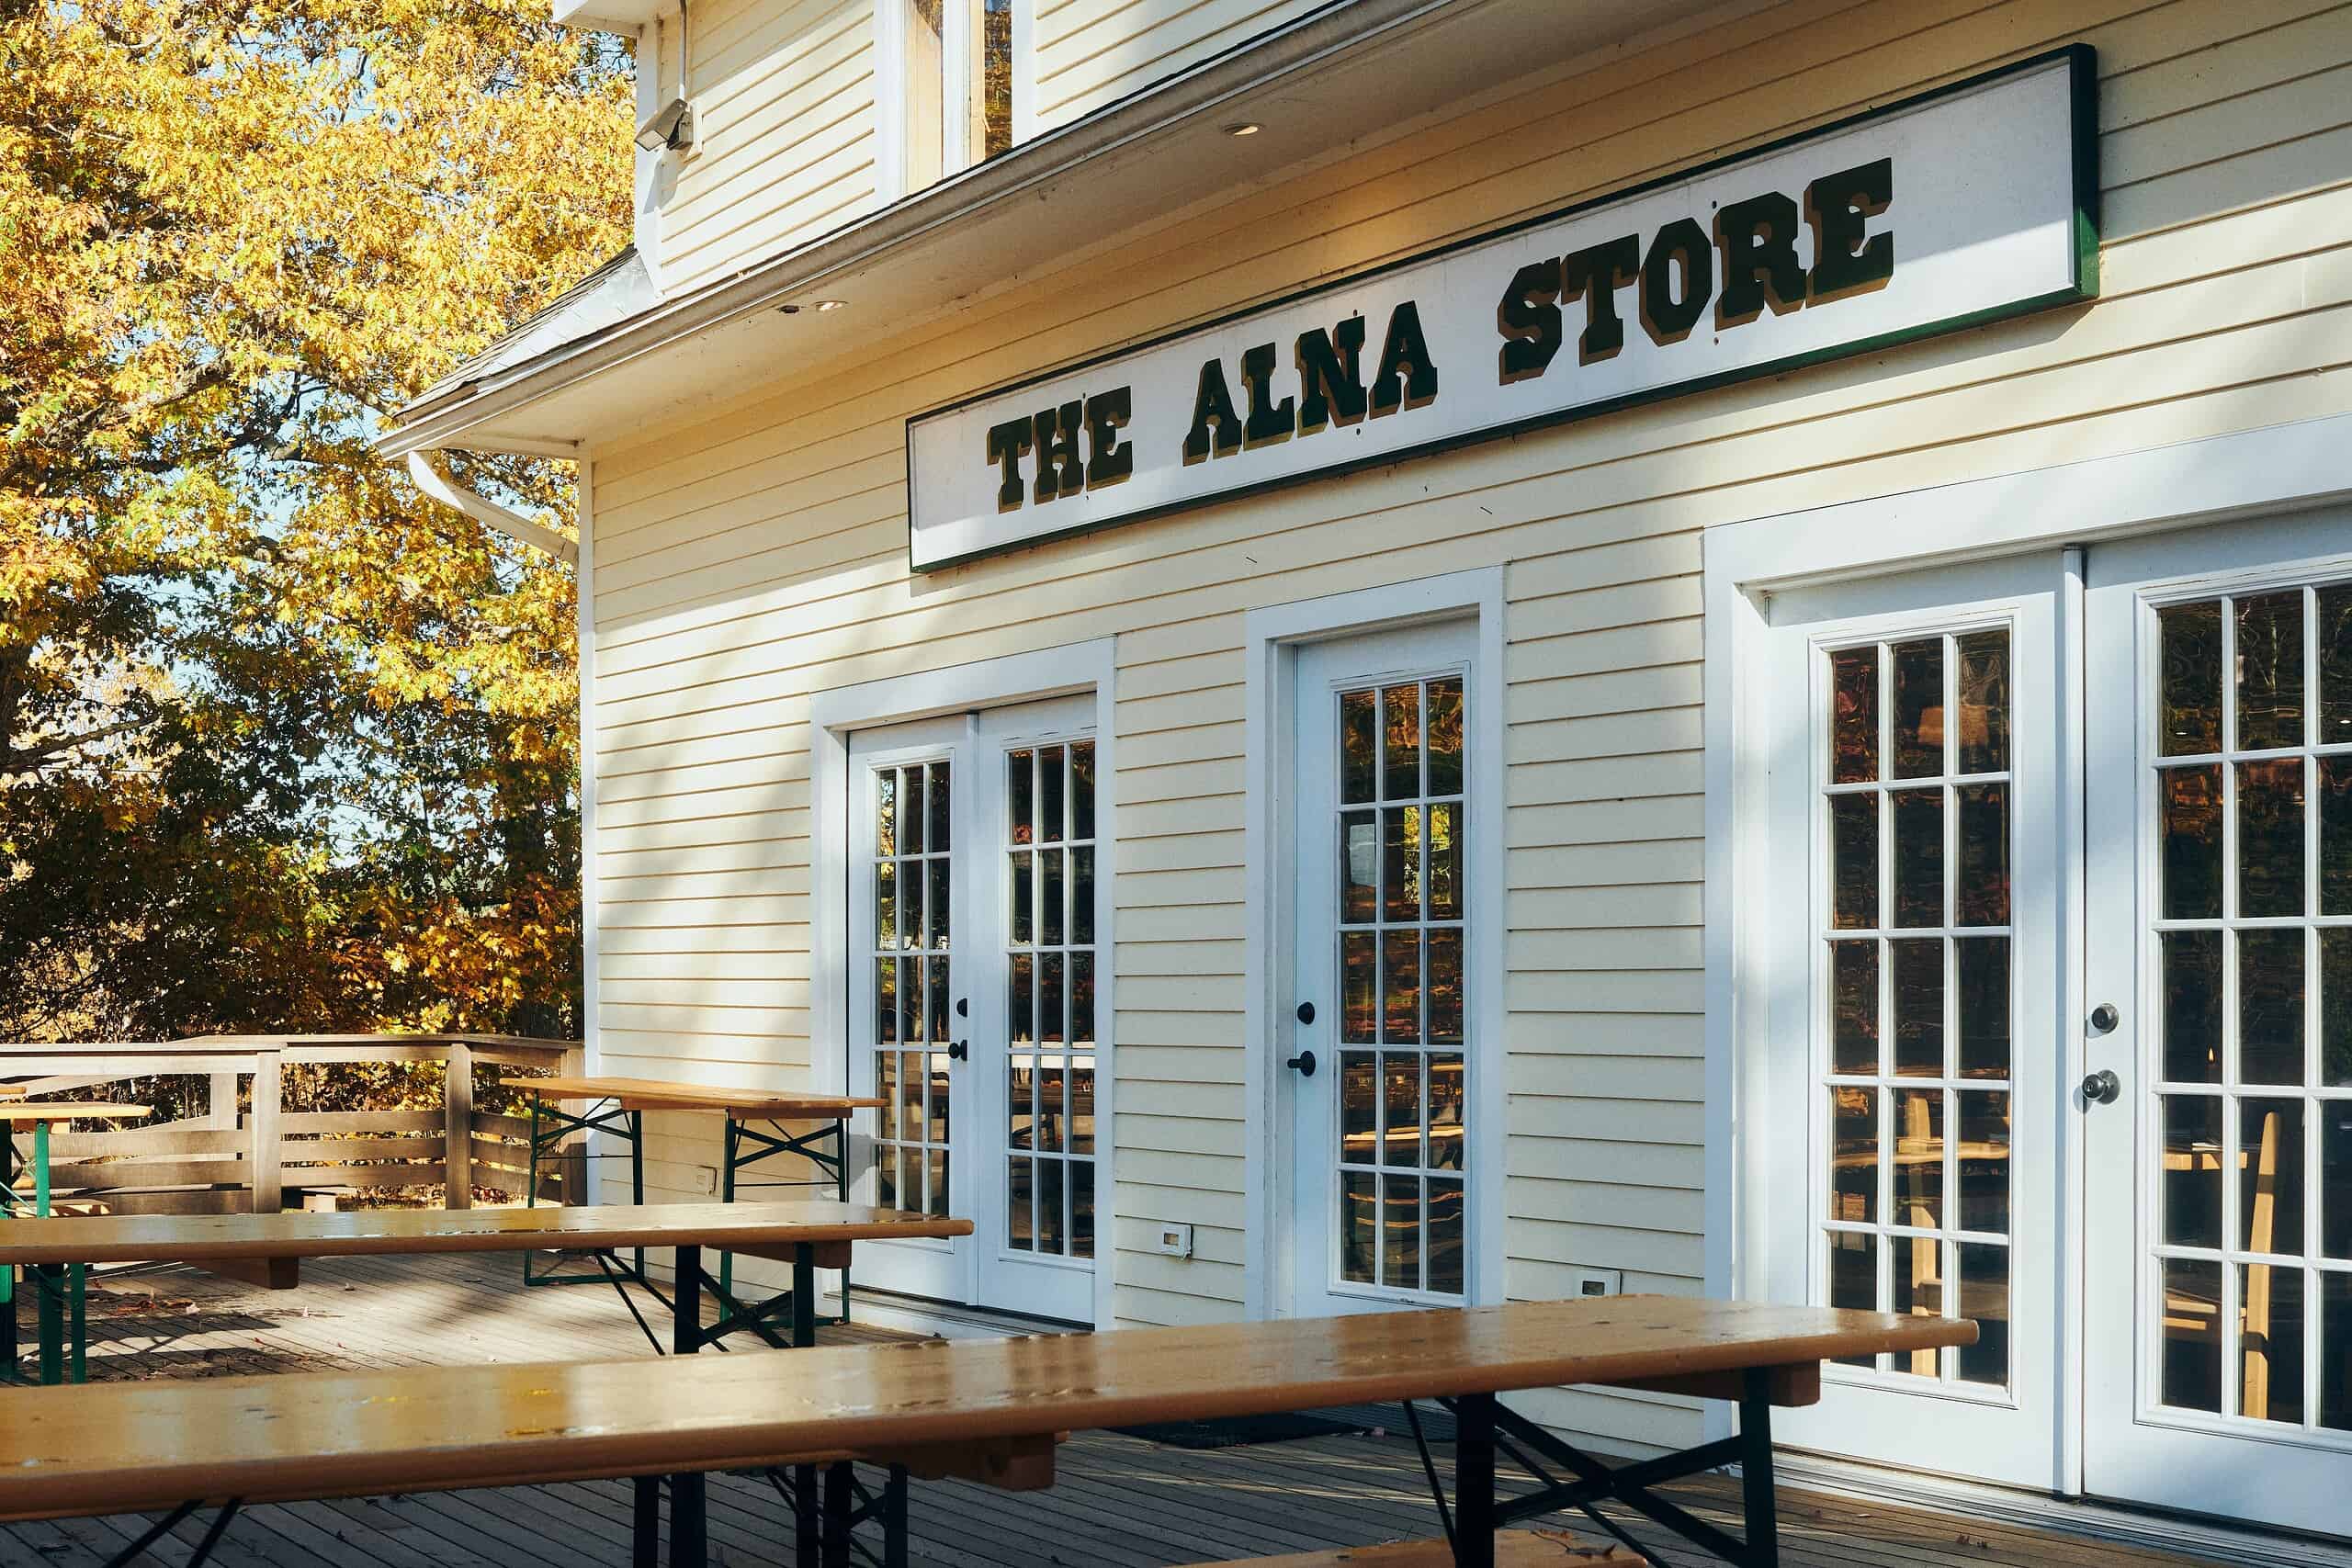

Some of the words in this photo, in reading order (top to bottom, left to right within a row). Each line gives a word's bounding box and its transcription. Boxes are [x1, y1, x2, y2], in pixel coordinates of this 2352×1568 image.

[987, 386, 1133, 514] THE
[1182, 300, 1438, 467] ALNA
[1498, 157, 1894, 386] STORE
